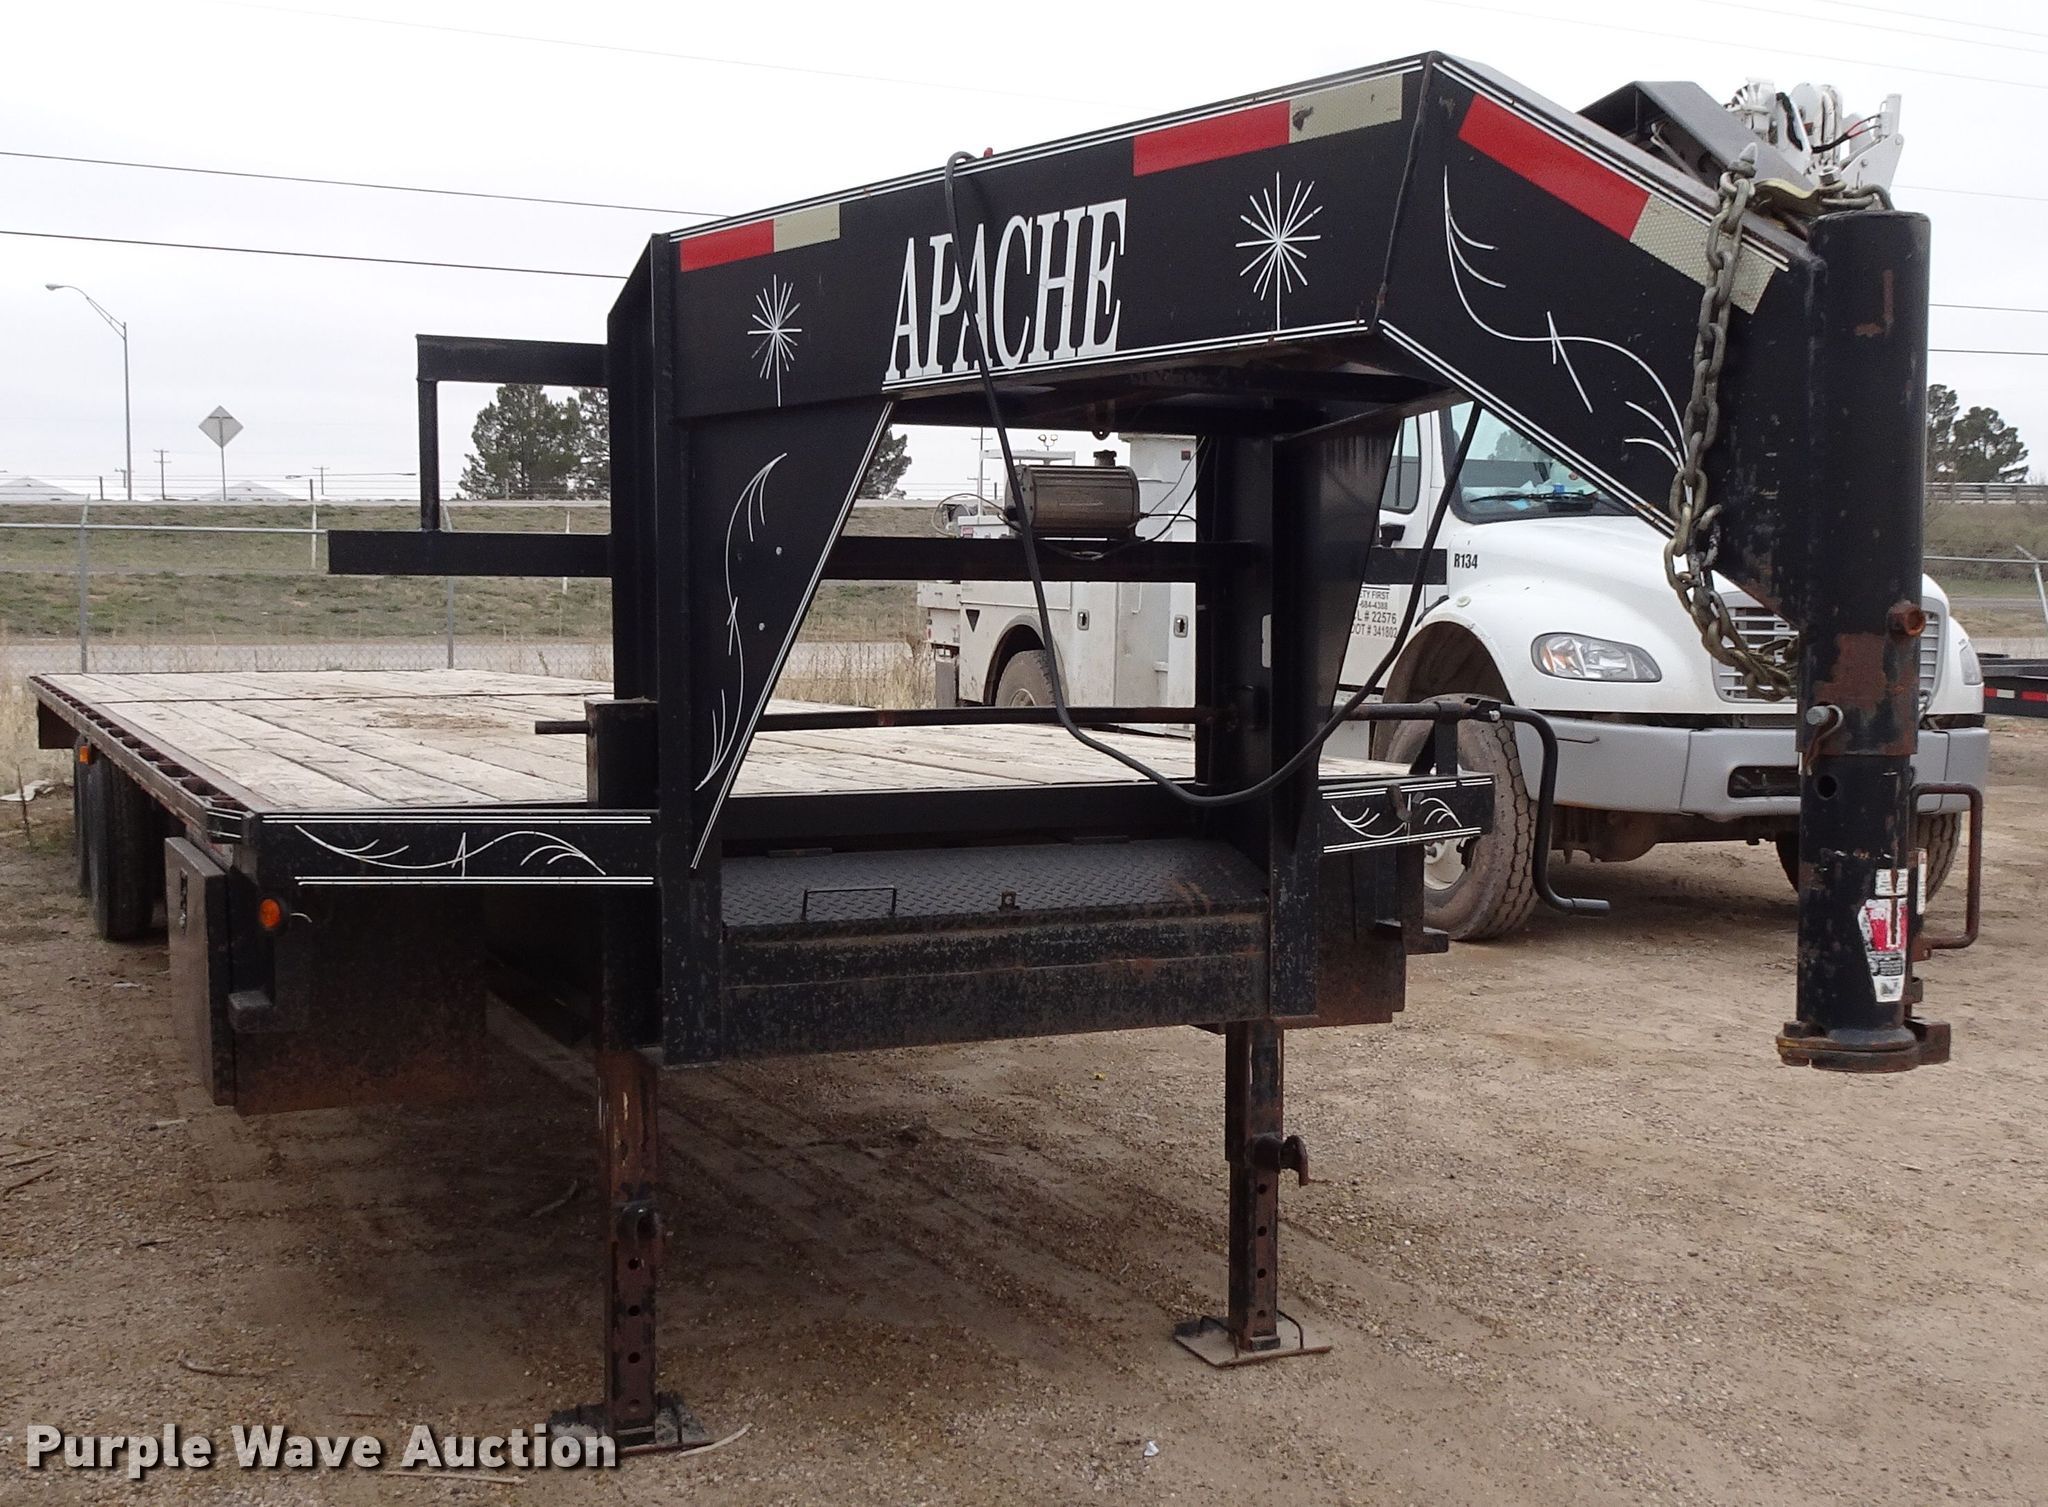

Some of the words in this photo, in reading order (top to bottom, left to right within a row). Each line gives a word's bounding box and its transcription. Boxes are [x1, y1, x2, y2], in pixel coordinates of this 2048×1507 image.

[885, 198, 1127, 382] APACHE
[1453, 553, 1478, 569] R134
[1372, 590, 1390, 600] FIRST
[1371, 611, 1397, 625] 22576
